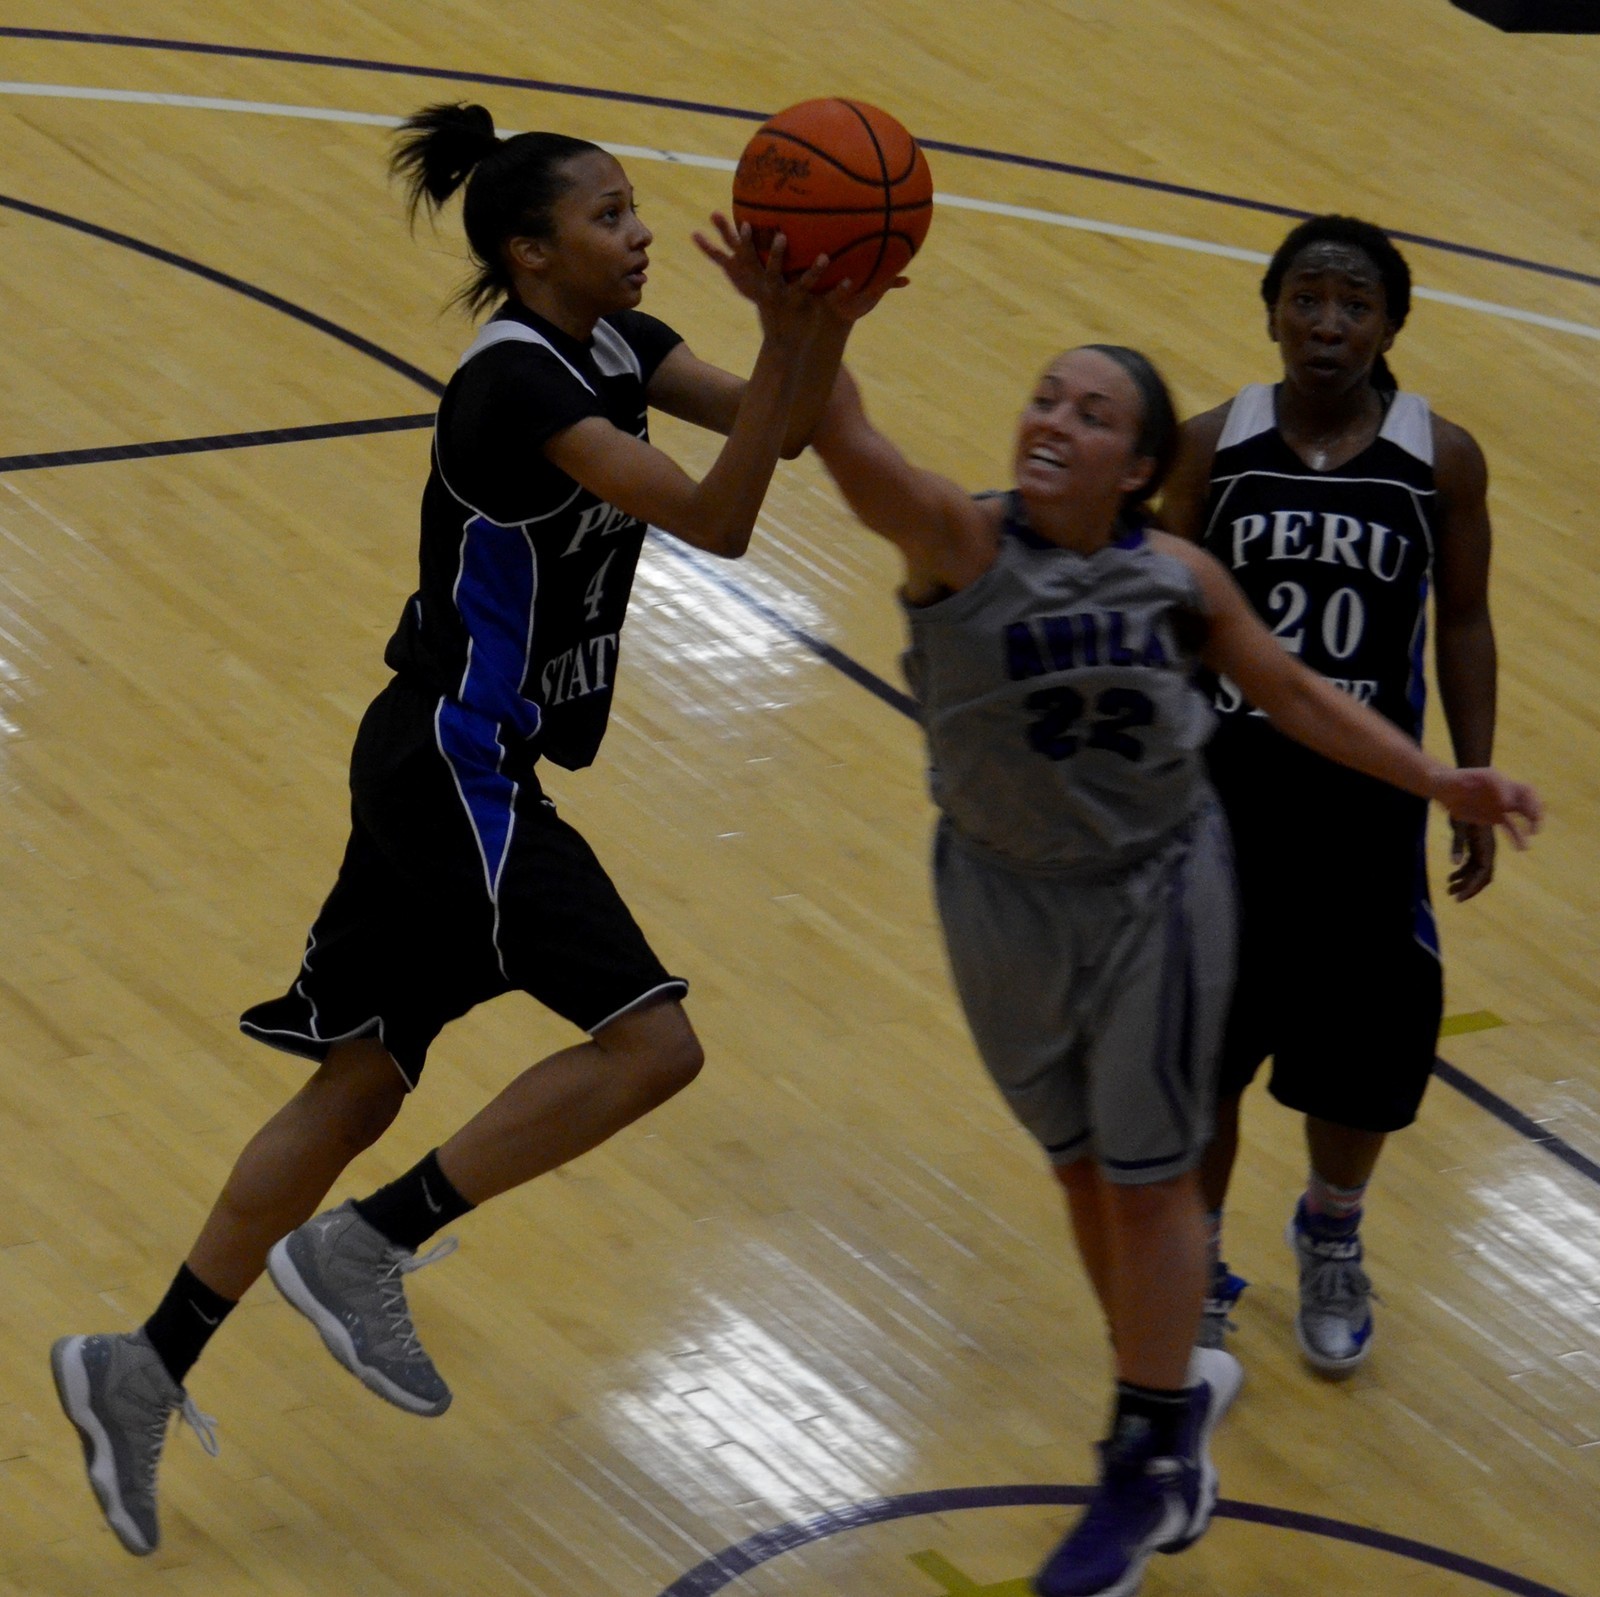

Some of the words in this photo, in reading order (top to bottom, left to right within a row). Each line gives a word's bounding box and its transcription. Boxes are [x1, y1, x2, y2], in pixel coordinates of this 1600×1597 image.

[560, 502, 637, 558] PE
[1231, 510, 1410, 582] PERU
[583, 547, 618, 622] 4
[1267, 580, 1366, 659] 20
[1006, 611, 1168, 681] AVILA
[1026, 686, 1154, 762] 22
